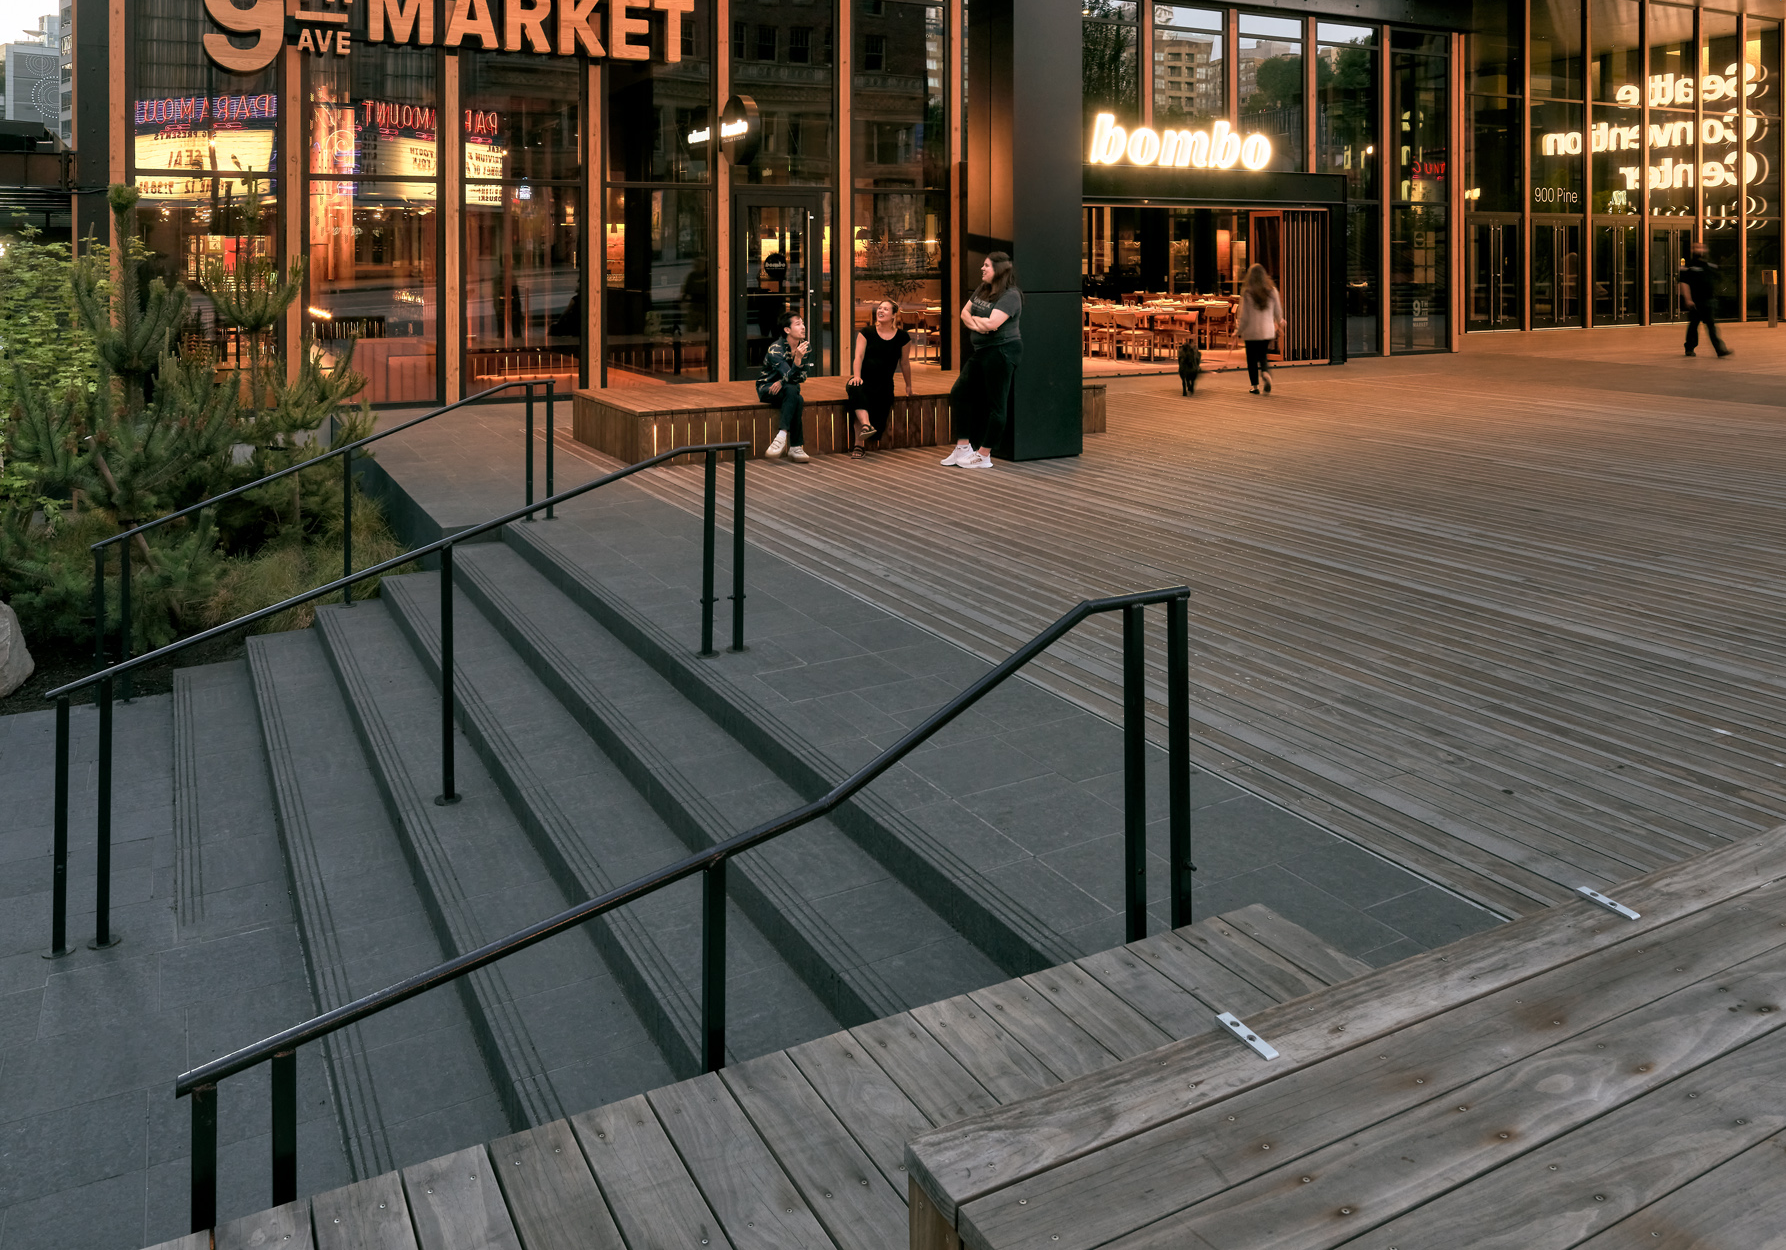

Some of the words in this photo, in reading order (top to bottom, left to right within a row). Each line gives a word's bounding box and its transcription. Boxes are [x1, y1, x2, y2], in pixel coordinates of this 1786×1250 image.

[297, 28, 351, 55] AVE
[1090, 113, 1272, 170] bombo
[1534, 187, 1555, 202] 900
[1557, 187, 1578, 203] Pine
